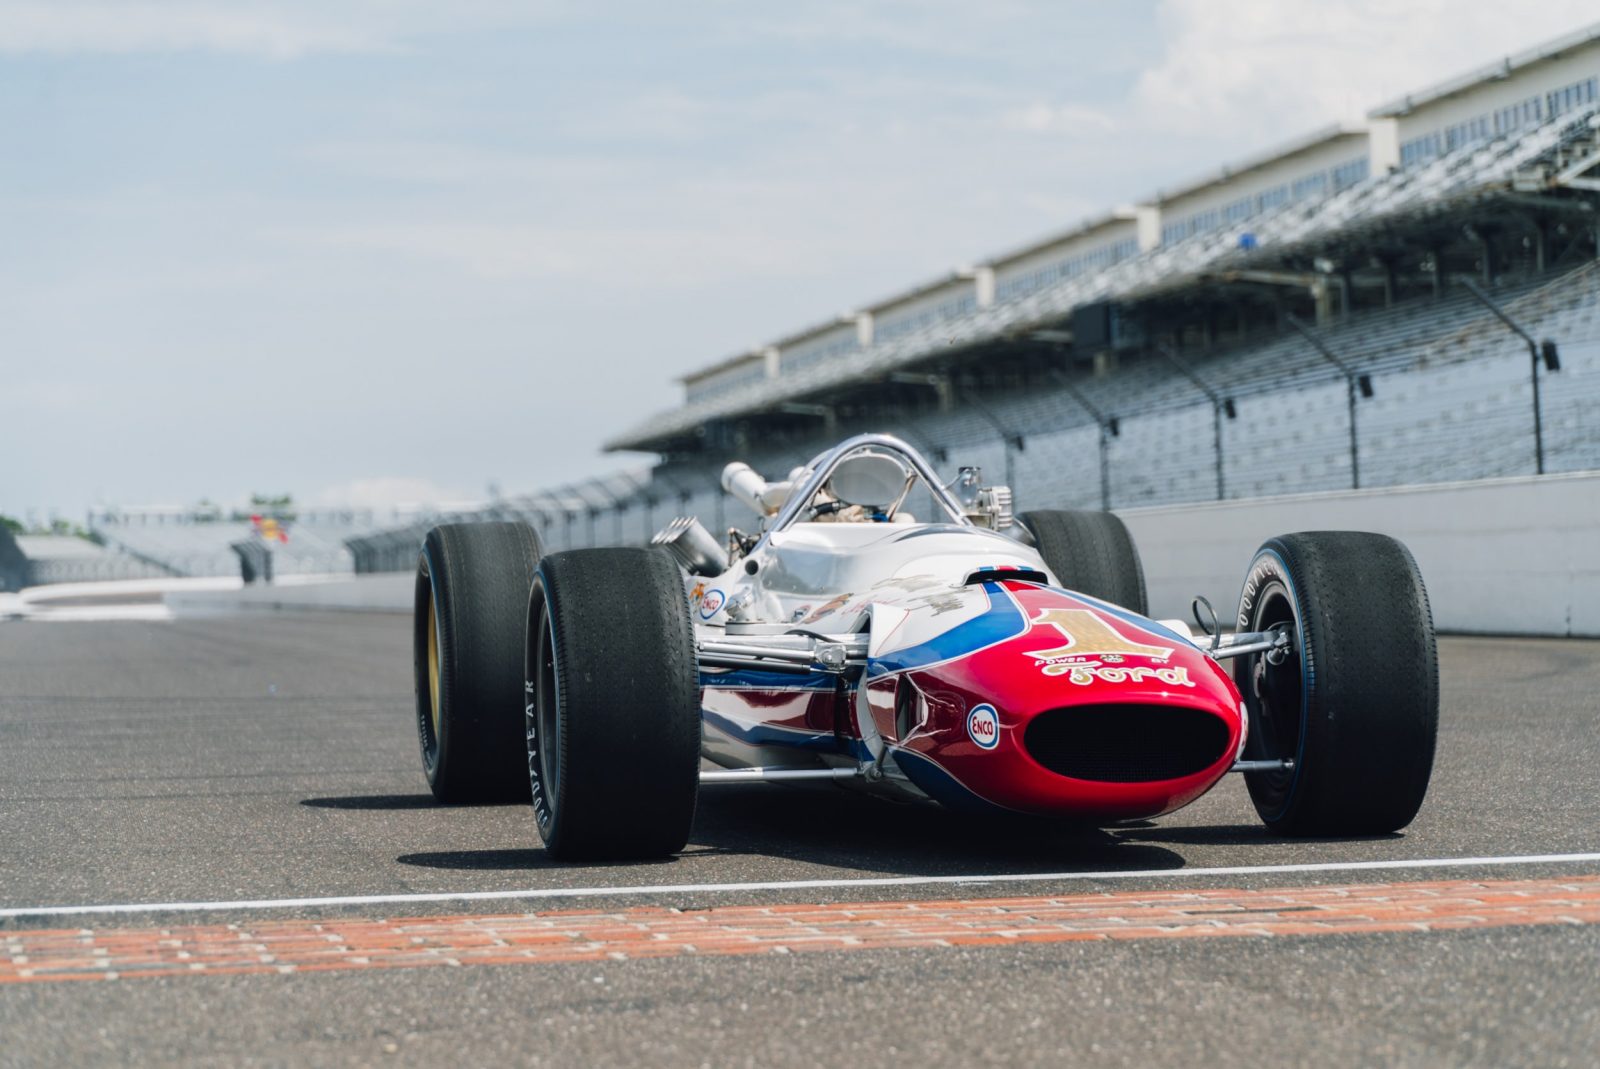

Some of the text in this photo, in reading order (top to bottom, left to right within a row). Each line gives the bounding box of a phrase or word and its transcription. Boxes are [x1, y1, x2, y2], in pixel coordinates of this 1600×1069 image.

[1022, 608, 1175, 659] 1
[1034, 656, 1087, 666] POWER
[1042, 660, 1196, 687] Ford
[972, 715, 994, 736] ENCO
